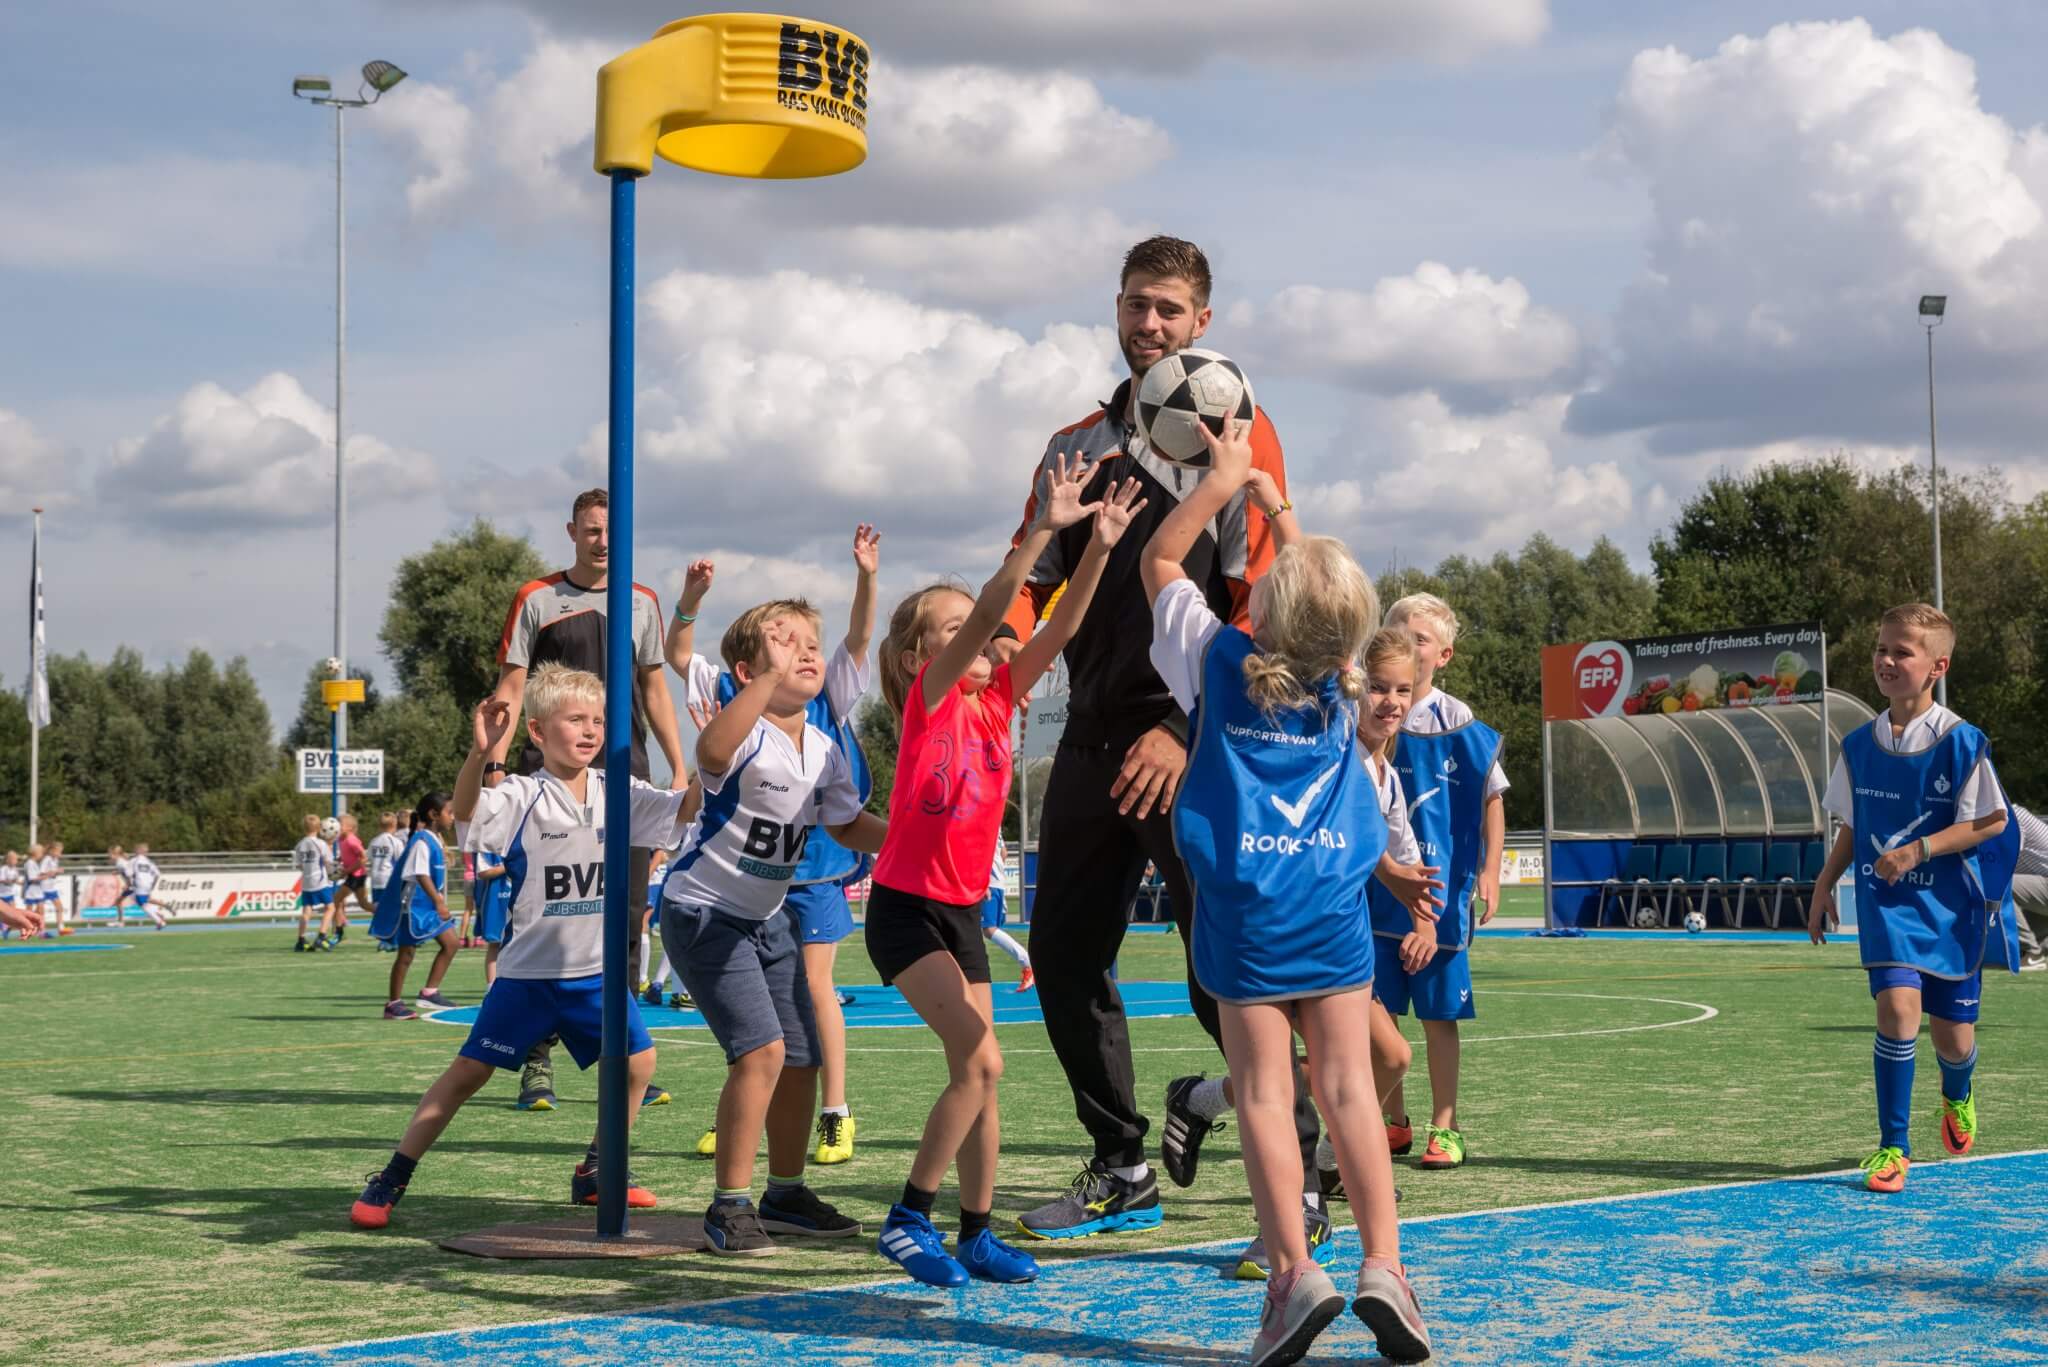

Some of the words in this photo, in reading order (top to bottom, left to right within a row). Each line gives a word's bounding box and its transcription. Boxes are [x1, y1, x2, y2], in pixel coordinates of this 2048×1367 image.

[810, 95, 841, 120] VAN
[1635, 642, 1669, 658] Taking
[1670, 642, 1693, 654] care
[1694, 637, 1708, 655] of
[1706, 635, 1762, 654] freshness.
[1764, 631, 1795, 646] Every
[1796, 628, 1821, 645] day.
[1225, 722, 1288, 744] SUPPORTER
[1292, 734, 1317, 746] VAN
[1885, 791, 1900, 800] VAN
[743, 816, 811, 863] BV
[1520, 856, 1545, 868] M-D
[201, 879, 214, 890] en
[544, 862, 604, 901] BV
